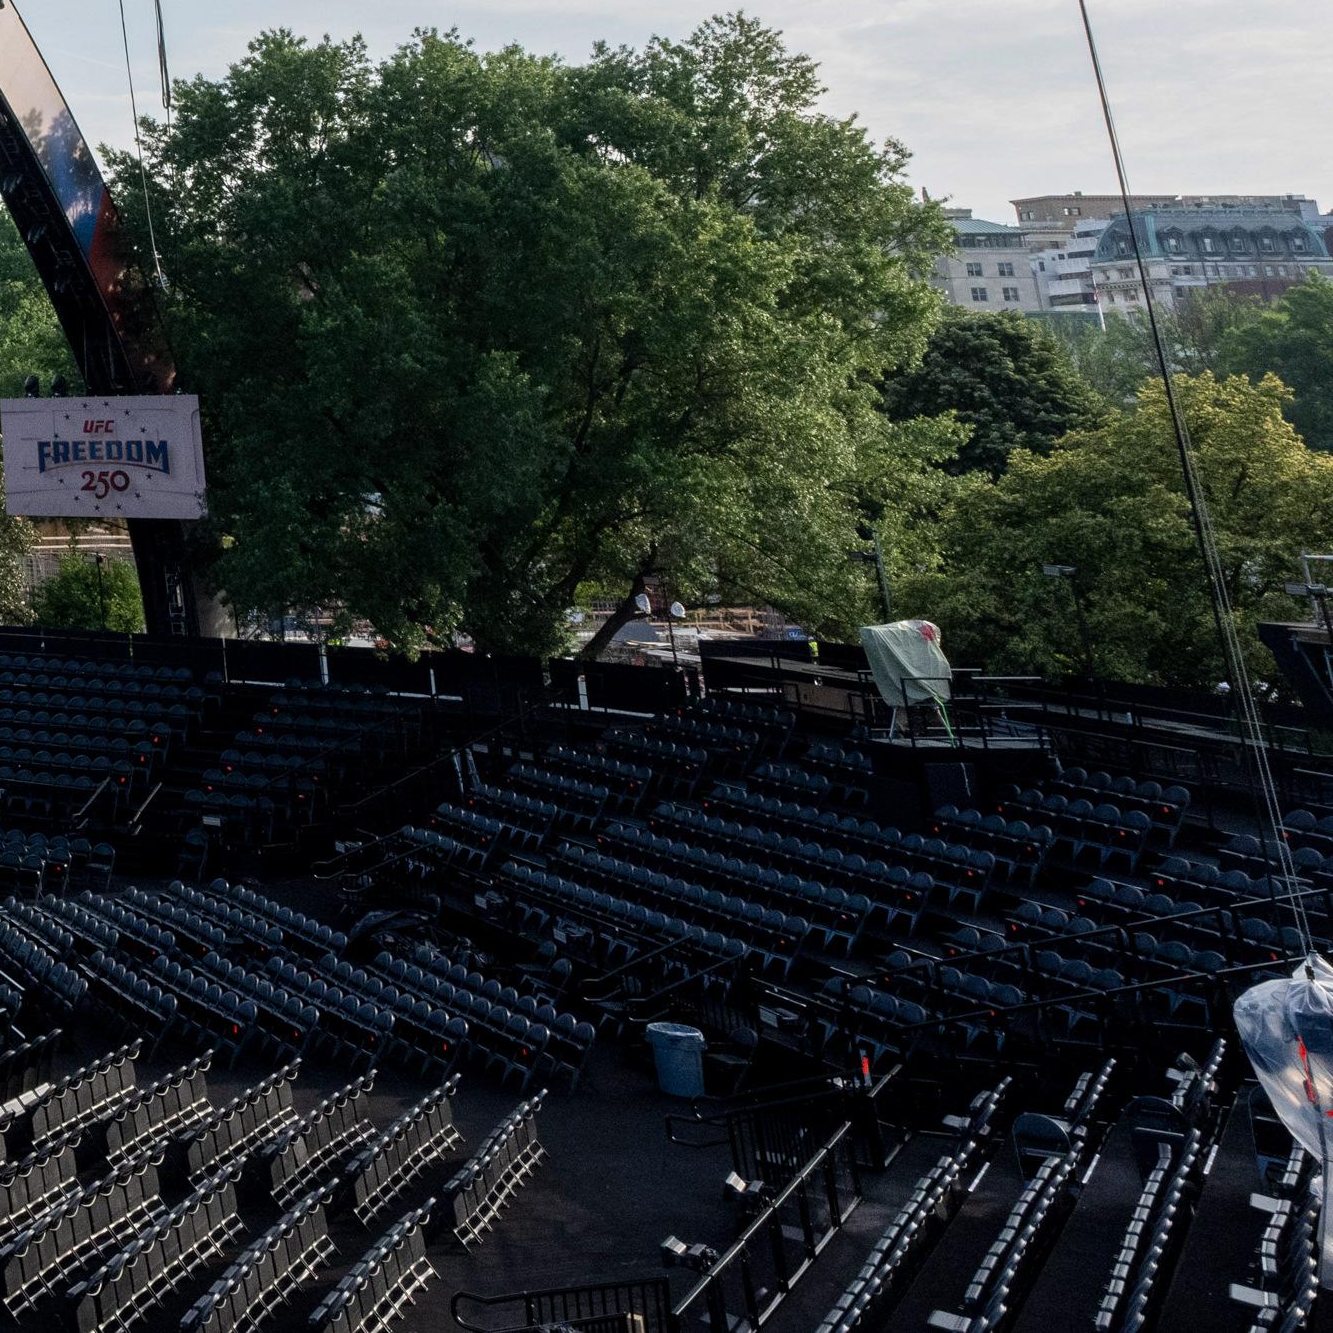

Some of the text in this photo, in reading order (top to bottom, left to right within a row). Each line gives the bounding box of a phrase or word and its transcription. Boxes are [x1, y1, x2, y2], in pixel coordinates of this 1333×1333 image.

[82, 419, 115, 434] UFC
[37, 440, 171, 476] FREEDOM
[80, 470, 131, 500] 250
